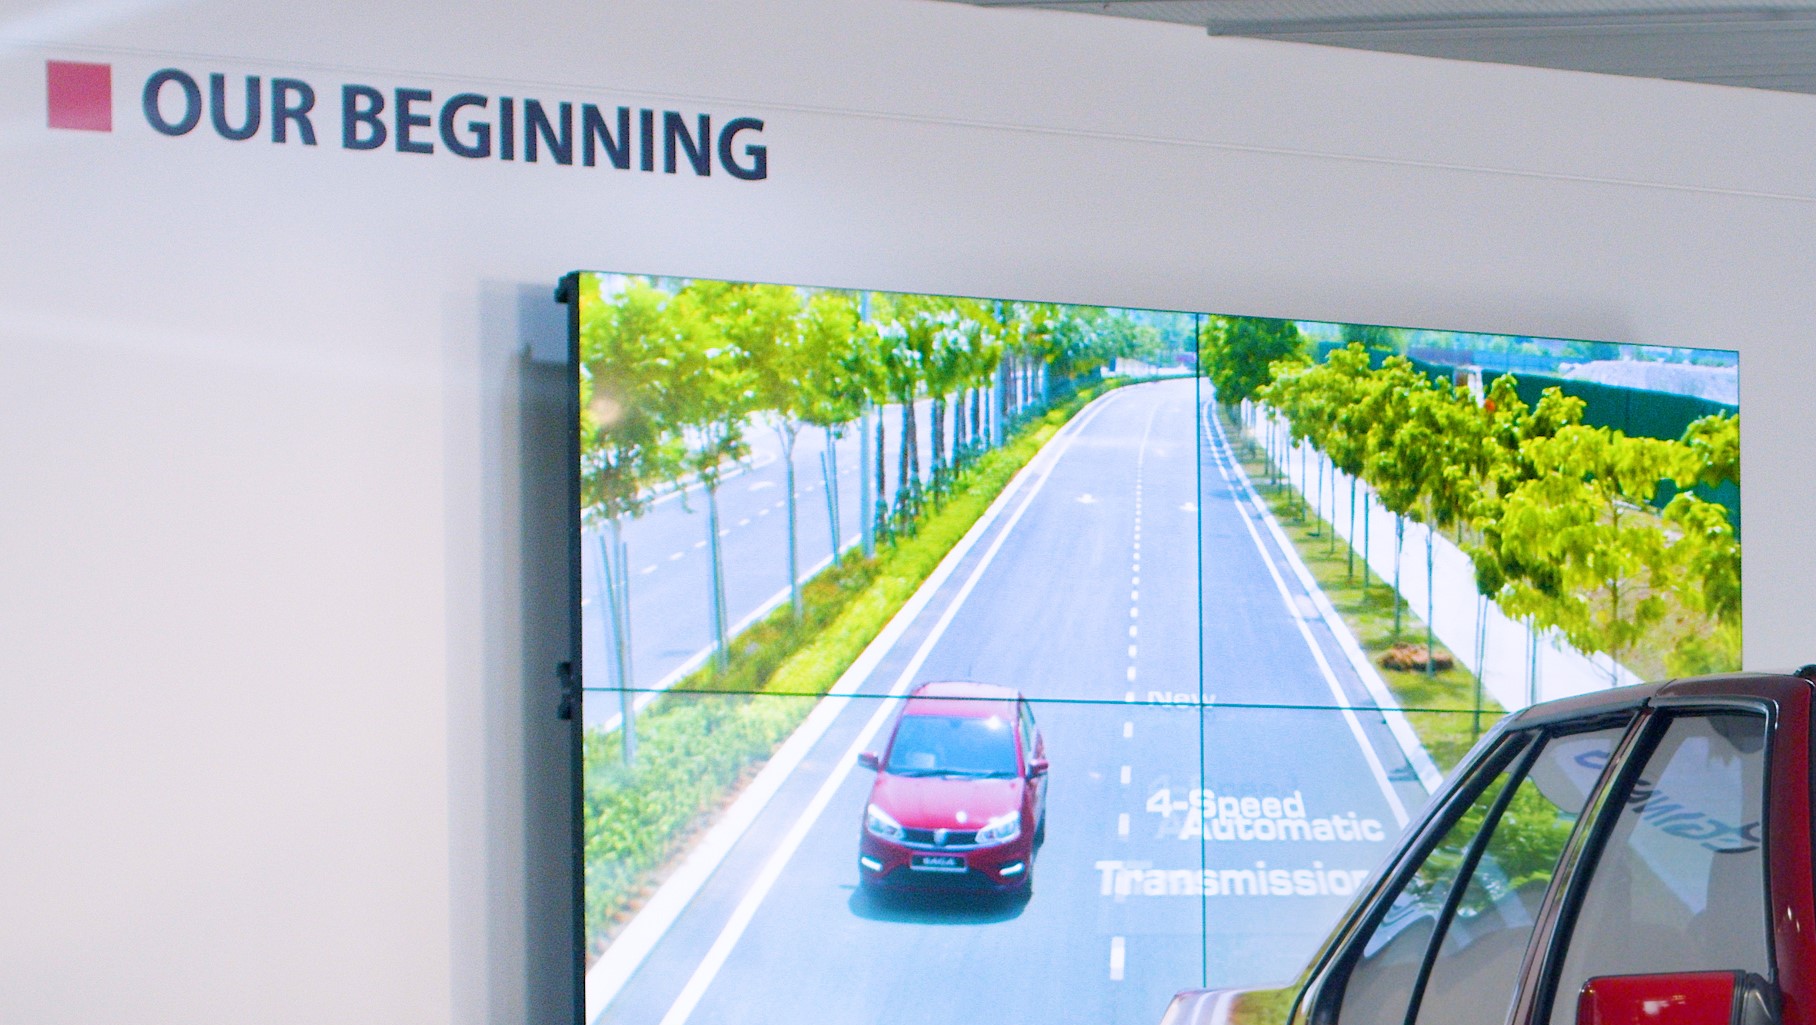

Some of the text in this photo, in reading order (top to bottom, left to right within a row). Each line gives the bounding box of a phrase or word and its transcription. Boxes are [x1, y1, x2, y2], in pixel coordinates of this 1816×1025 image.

[142, 68, 768, 182] OUR BEGINNING
[1148, 690, 1217, 708] New
[1146, 788, 1306, 826] 4-Speed
[1178, 808, 1386, 842] Automatic
